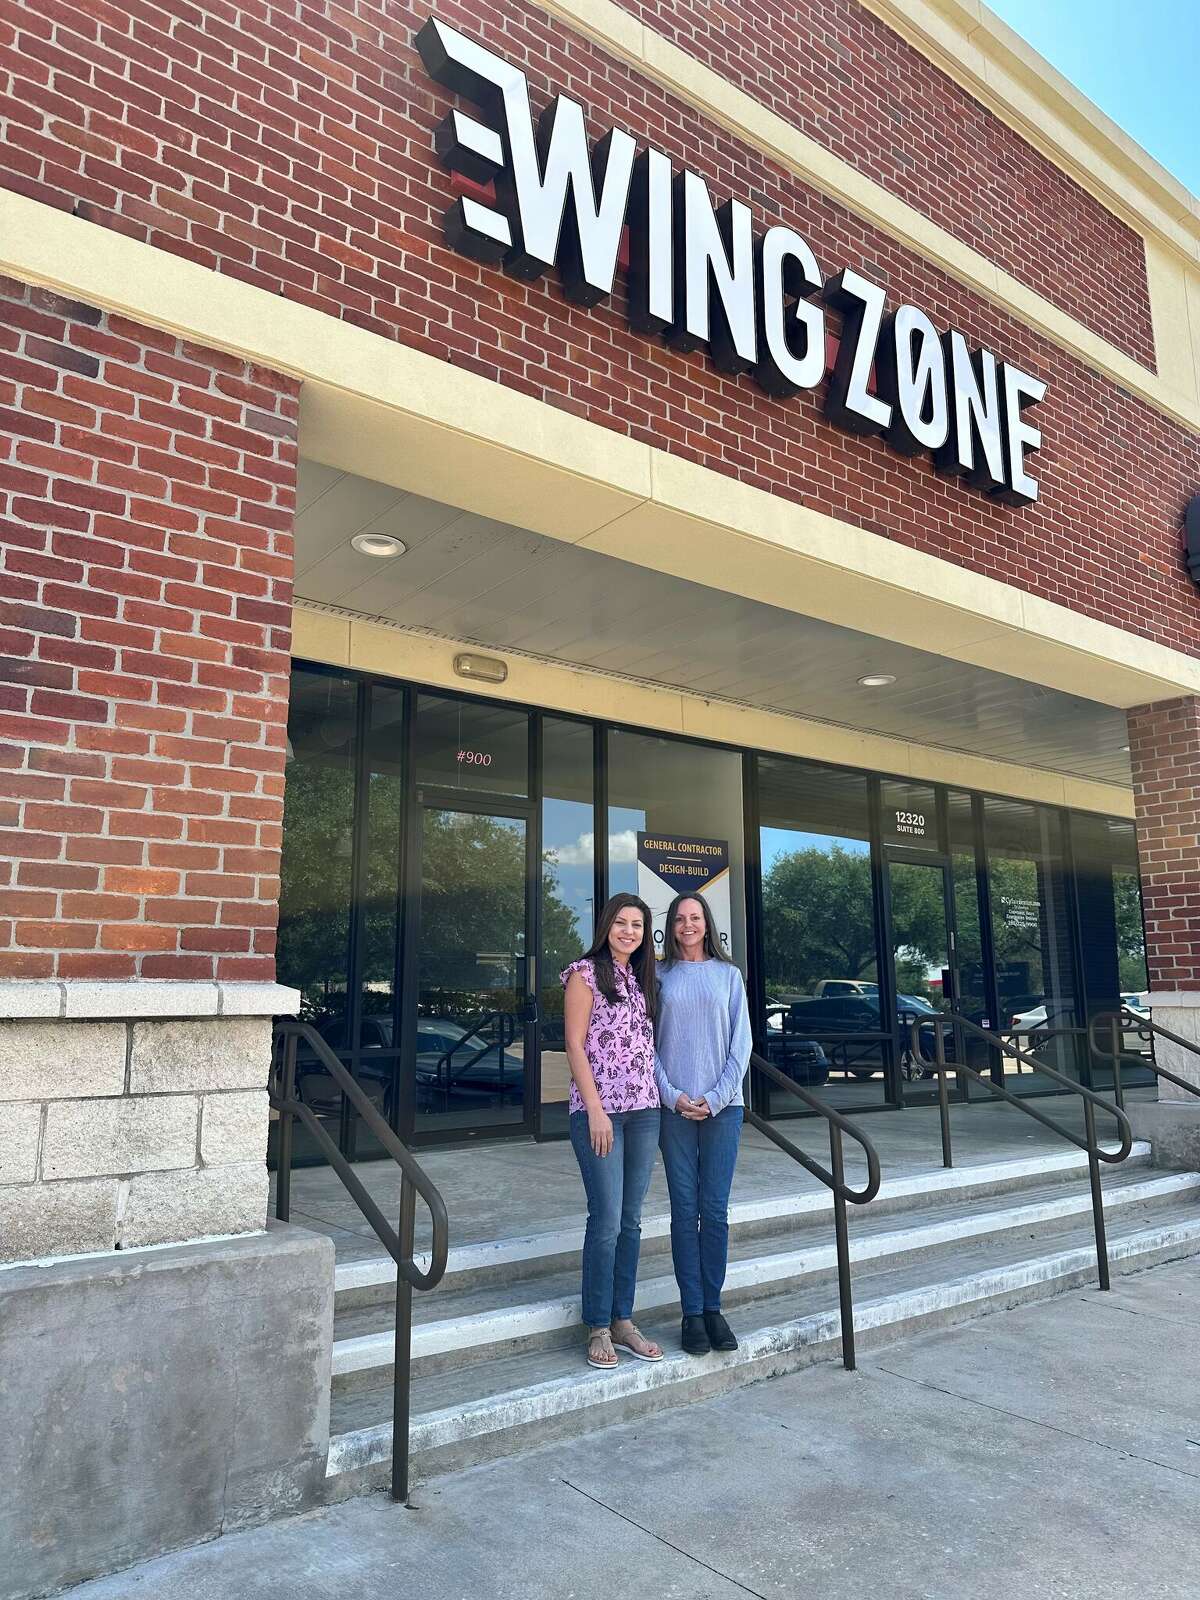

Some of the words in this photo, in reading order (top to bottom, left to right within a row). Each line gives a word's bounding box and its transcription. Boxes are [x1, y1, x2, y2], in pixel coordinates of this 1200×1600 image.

[416, 16, 828, 397] WING
[457, 750, 492, 766] #900
[895, 811, 925, 826] 12320
[896, 825, 914, 834] SUITE
[643, 839, 677, 851] GENERAL
[677, 843, 722, 855] CONTRACTOR
[659, 863, 709, 877] DESIGN-BUILD
